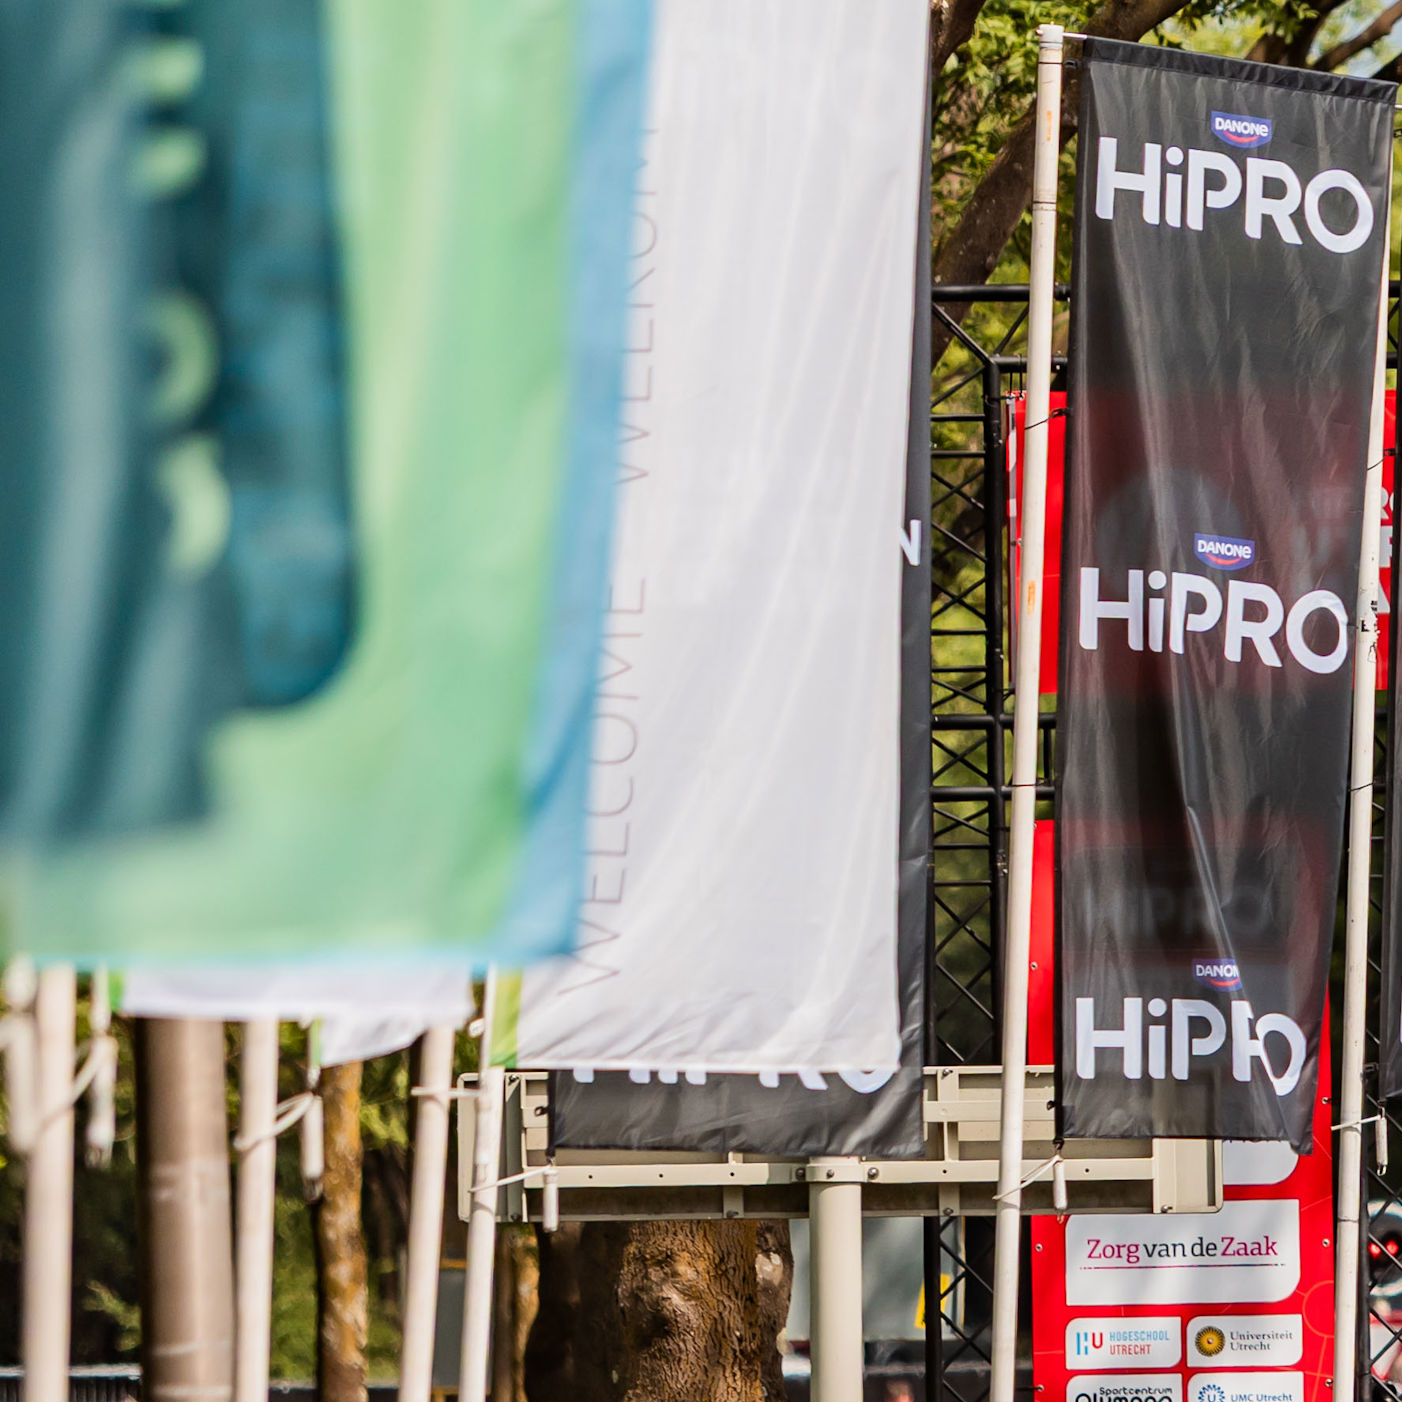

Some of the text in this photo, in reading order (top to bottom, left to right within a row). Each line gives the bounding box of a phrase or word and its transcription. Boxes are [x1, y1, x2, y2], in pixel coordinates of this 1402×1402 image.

[1096, 136, 1374, 254] HiPRO
[1079, 566, 1348, 674] HiPRO
[1086, 1238, 1140, 1264] Zorg
[1220, 1235, 1278, 1258] Zaak
[1109, 1330, 1170, 1342] HOGESCHOOL
[1229, 1330, 1293, 1341] Universiteit
[1109, 1344, 1152, 1356] UTRECHT
[1229, 1341, 1271, 1351] Utrecht
[1099, 1386, 1173, 1396] Sportcentrum
[1230, 1392, 1293, 1402] UMC Utrecht
